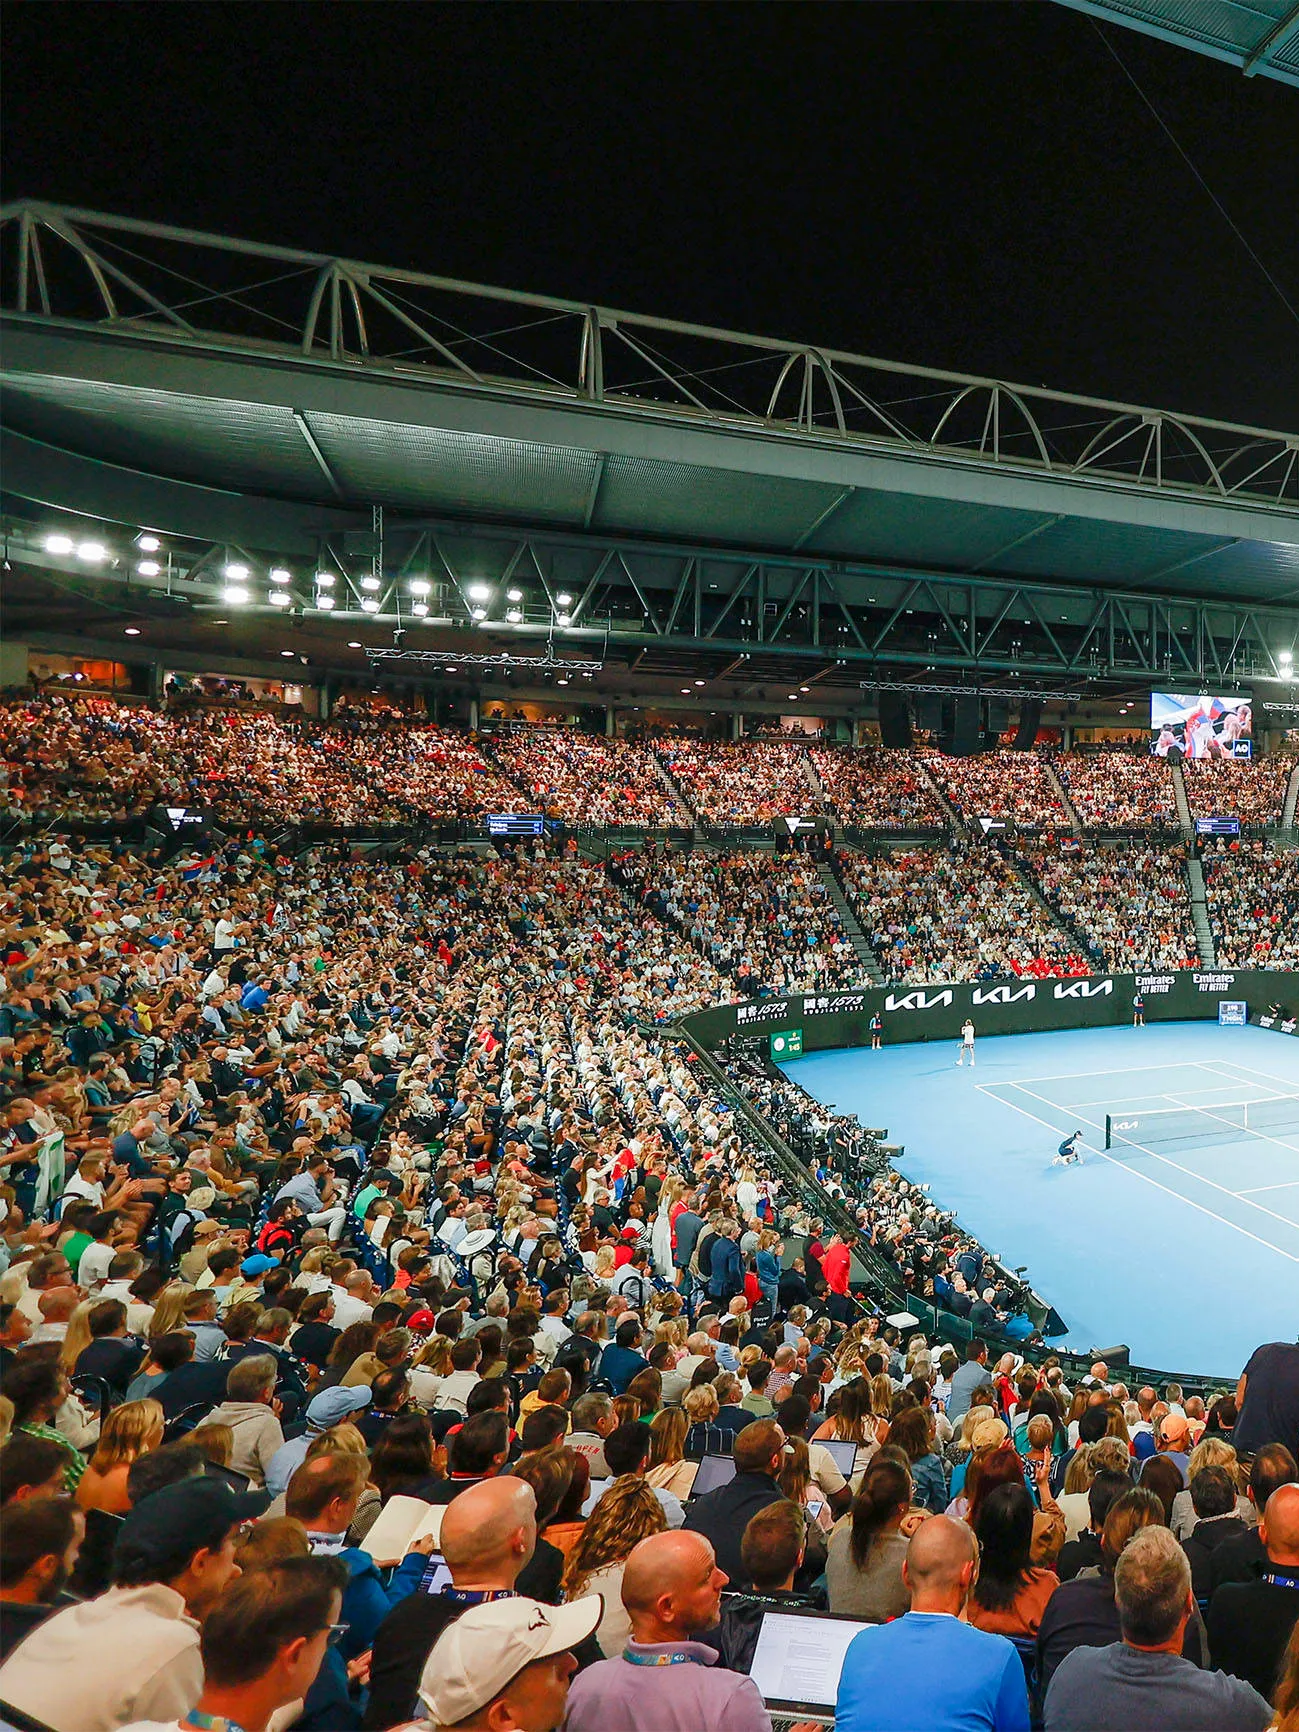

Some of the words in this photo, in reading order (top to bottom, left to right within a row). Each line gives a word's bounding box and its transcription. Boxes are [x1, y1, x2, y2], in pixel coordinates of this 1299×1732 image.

[1235, 744, 1248, 753] AO
[1135, 975, 1175, 986] Emirates
[1193, 973, 1234, 983] Emirates
[1054, 979, 1113, 999] KIA
[1150, 984, 1169, 993] BETTER
[1199, 984, 1208, 992] FLY
[1209, 982, 1229, 991] BETTER
[972, 984, 1036, 1004] KIA
[885, 990, 953, 1011] KIA
